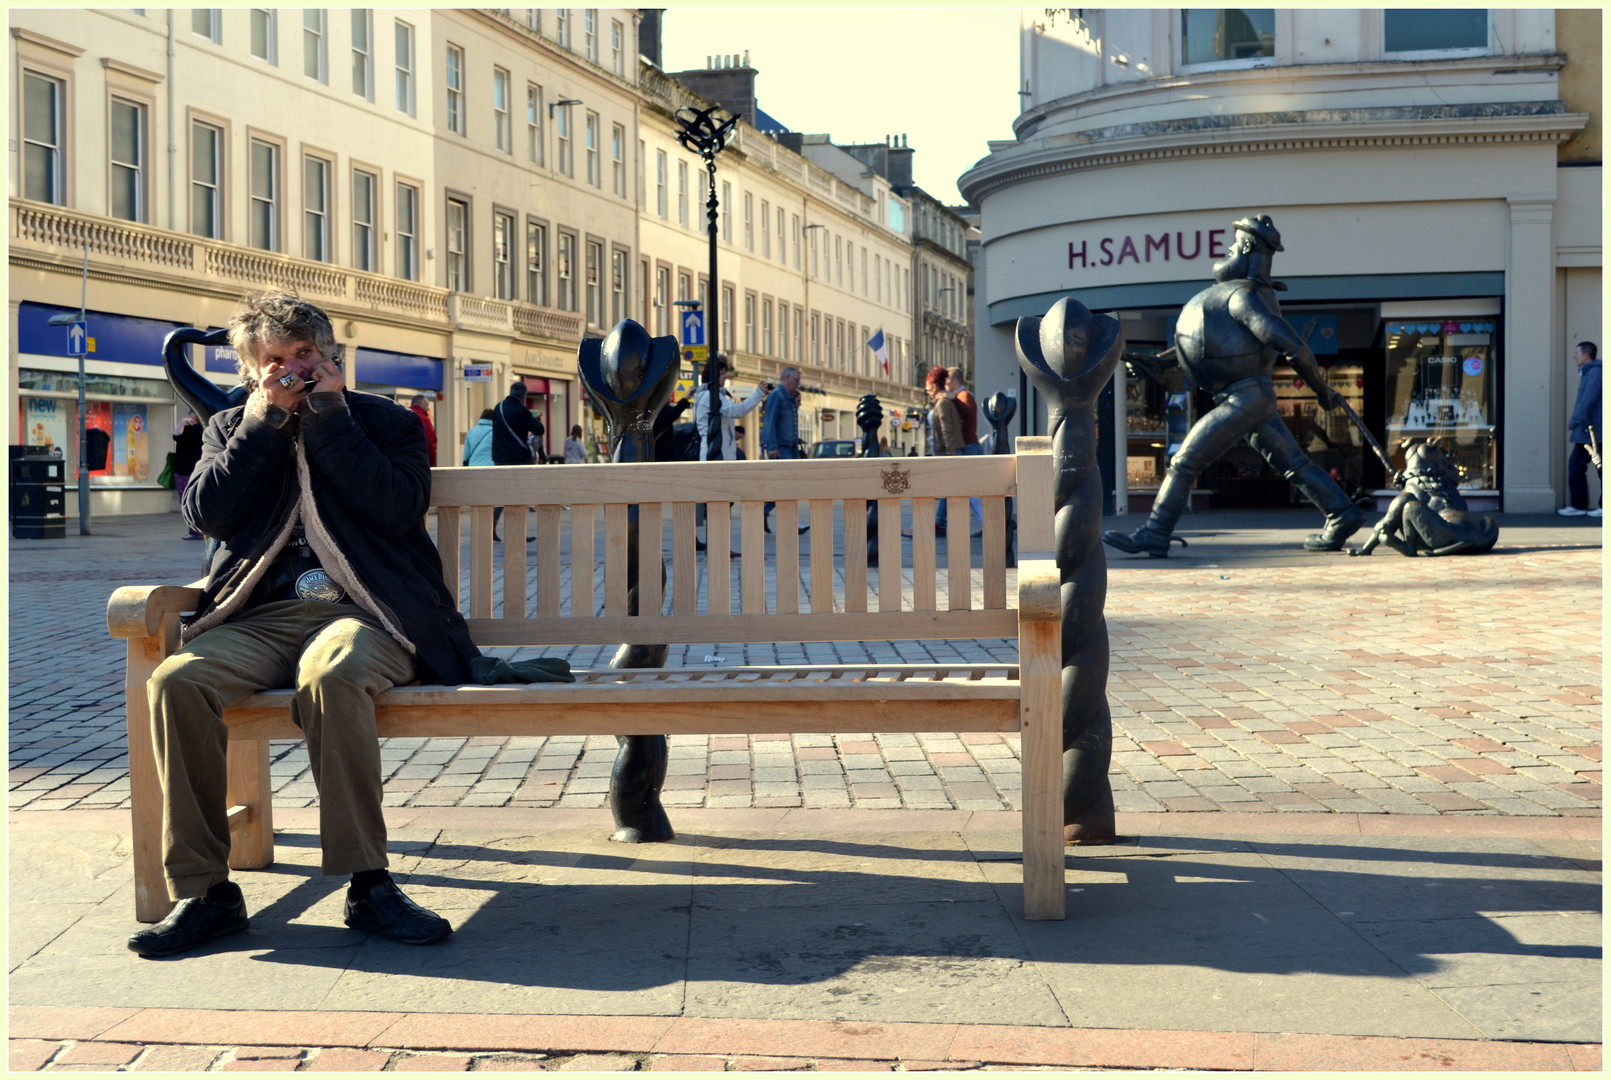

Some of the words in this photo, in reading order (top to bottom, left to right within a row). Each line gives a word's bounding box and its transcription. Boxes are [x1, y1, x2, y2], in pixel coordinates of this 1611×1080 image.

[1068, 229, 1226, 270] H.SAMUE
[215, 345, 239, 361] pharm
[29, 398, 57, 413] new
